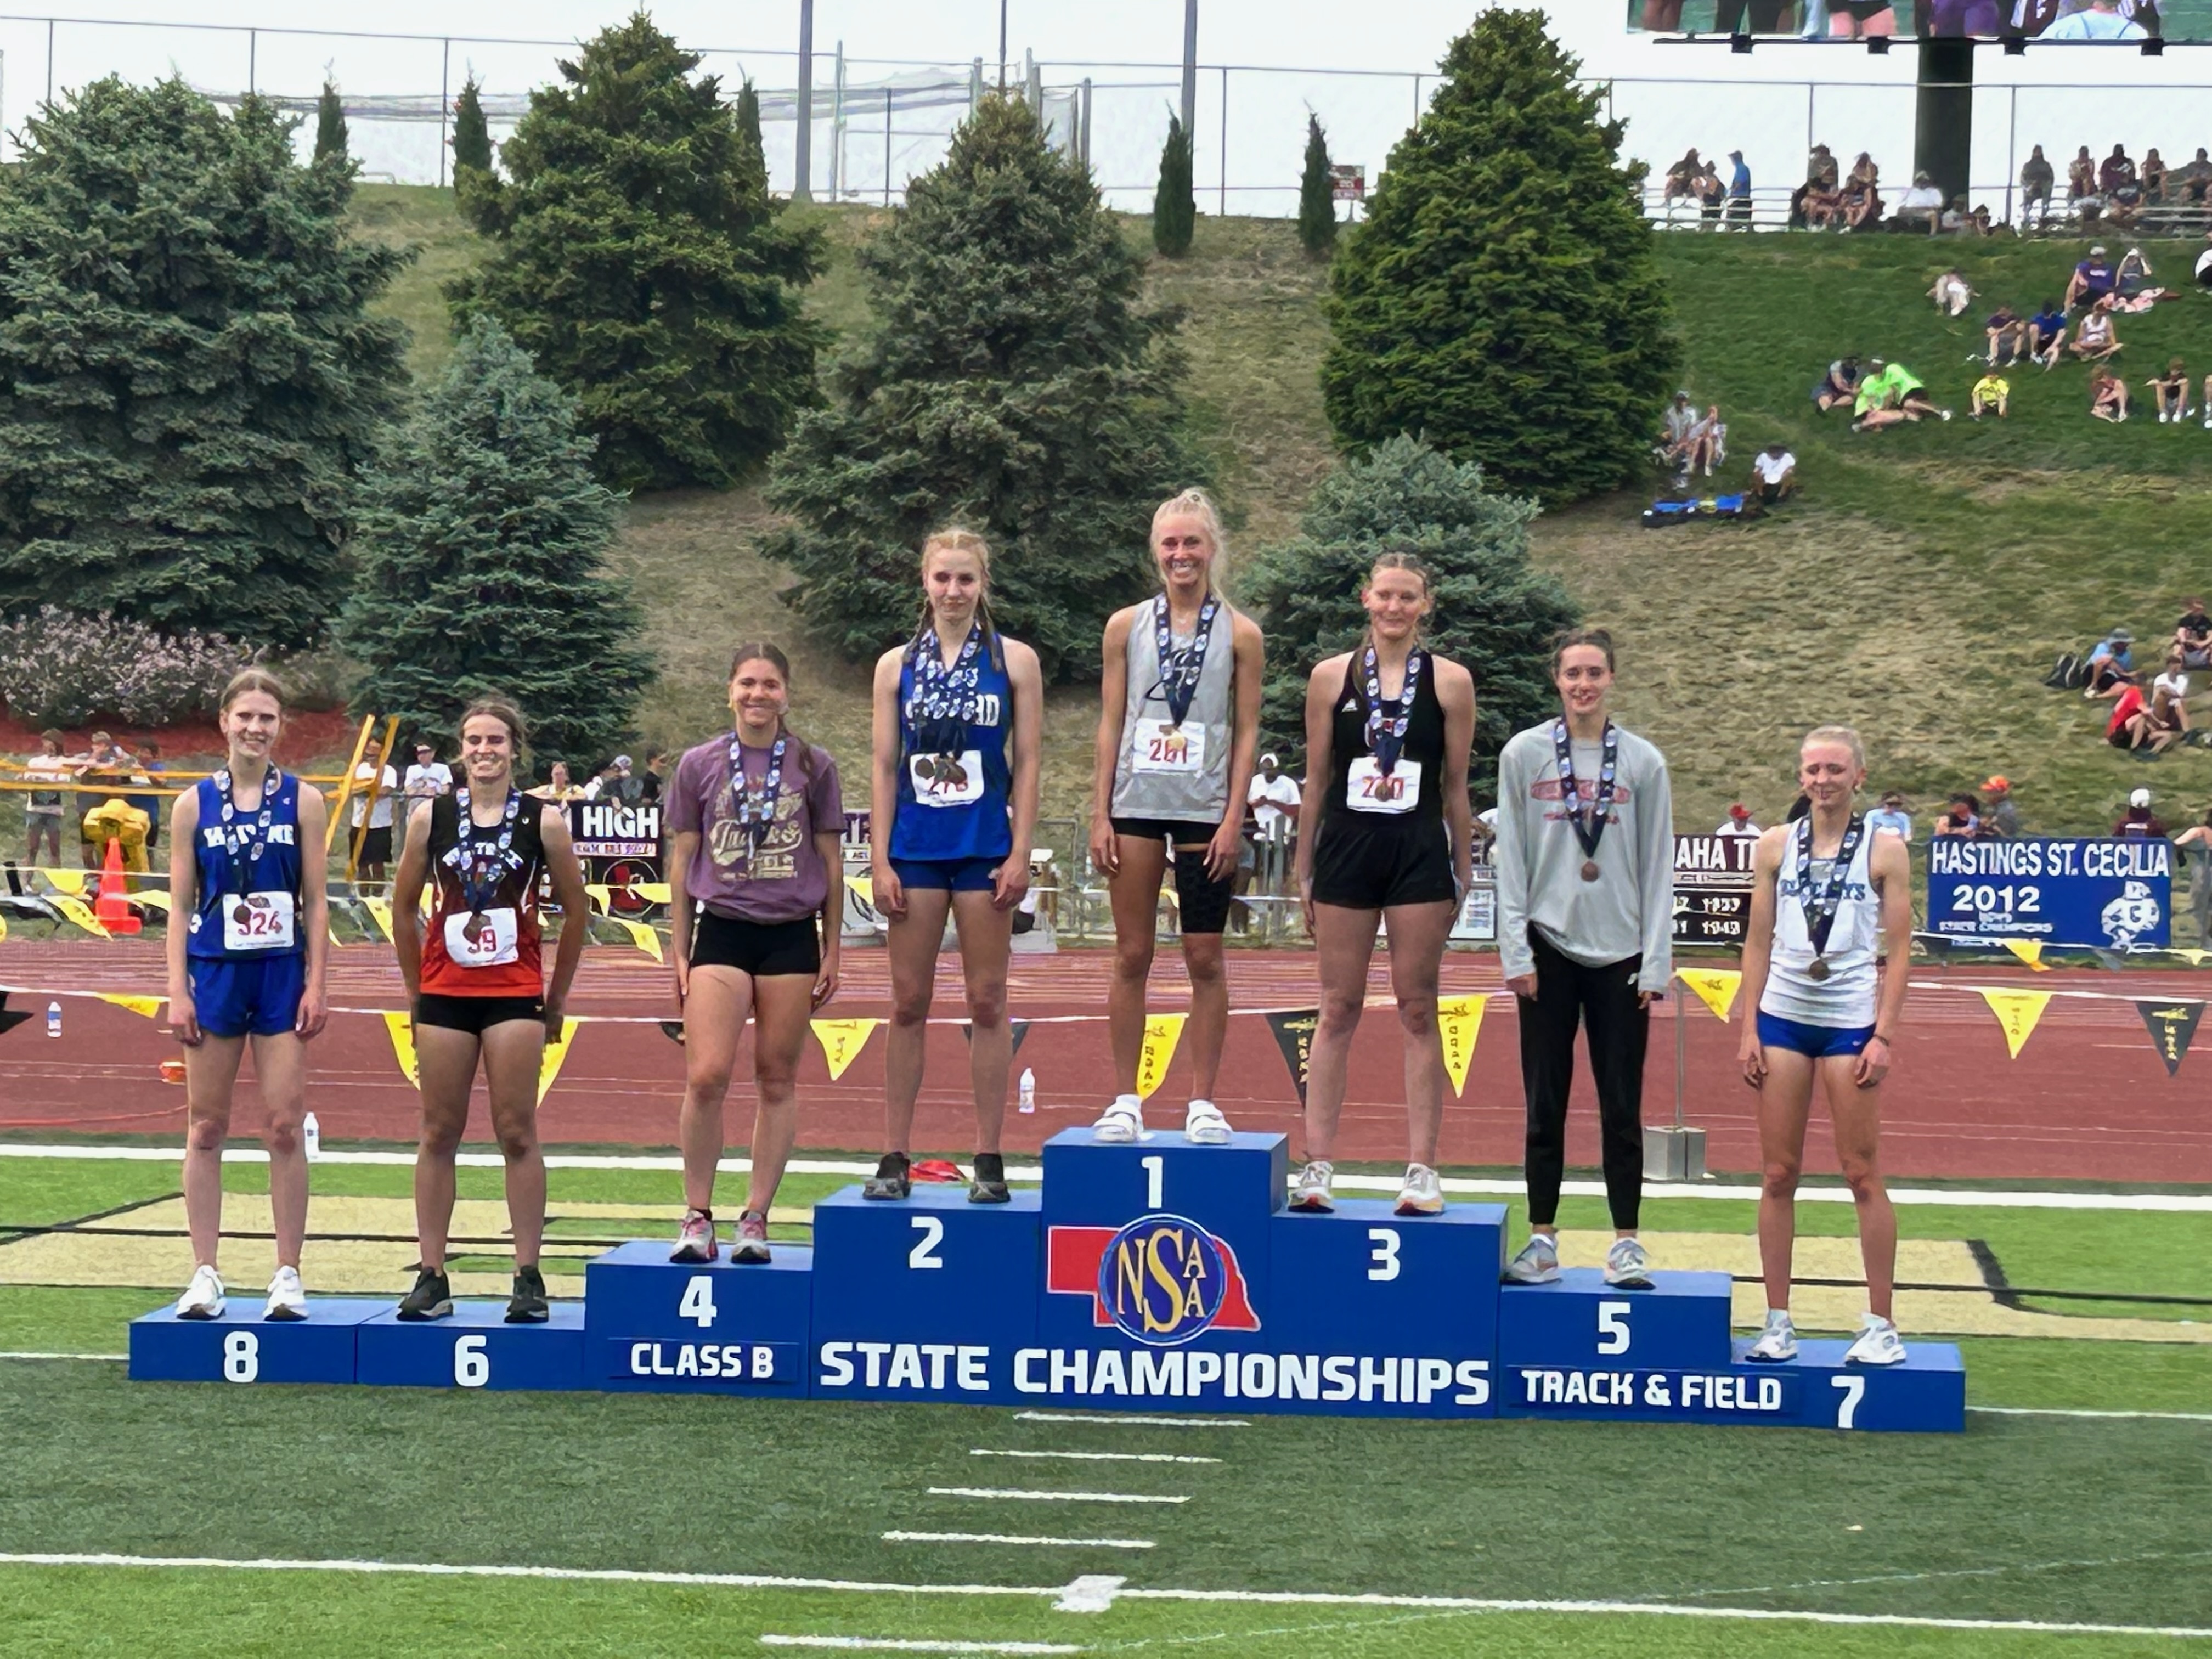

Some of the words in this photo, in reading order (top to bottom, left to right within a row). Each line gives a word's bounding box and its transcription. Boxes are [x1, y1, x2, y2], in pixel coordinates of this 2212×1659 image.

[583, 806, 658, 838] HIGH
[1673, 837, 1726, 870] AHA
[1932, 841, 2042, 876] HASTINGS
[2047, 842, 2079, 877] ST.
[2084, 843, 2169, 877] CECILIA
[1952, 884, 2041, 912] 2012
[1142, 1156, 1163, 1209] 1
[909, 1216, 943, 1268] 2
[1368, 1228, 1401, 1281] 3
[679, 1276, 717, 1327] 4
[1598, 1301, 1630, 1355] 5
[224, 1331, 258, 1383] 8
[455, 1335, 489, 1387] 6
[631, 1343, 742, 1377] CLASS
[752, 1346, 774, 1378] B
[821, 1342, 989, 1390] STATE
[1014, 1348, 1490, 1406] CHAMPIONSHIPS
[1521, 1370, 1634, 1405] TRACK
[1644, 1374, 1671, 1406] &
[1681, 1375, 1781, 1410] FIELD
[1831, 1375, 1865, 1429] 7
